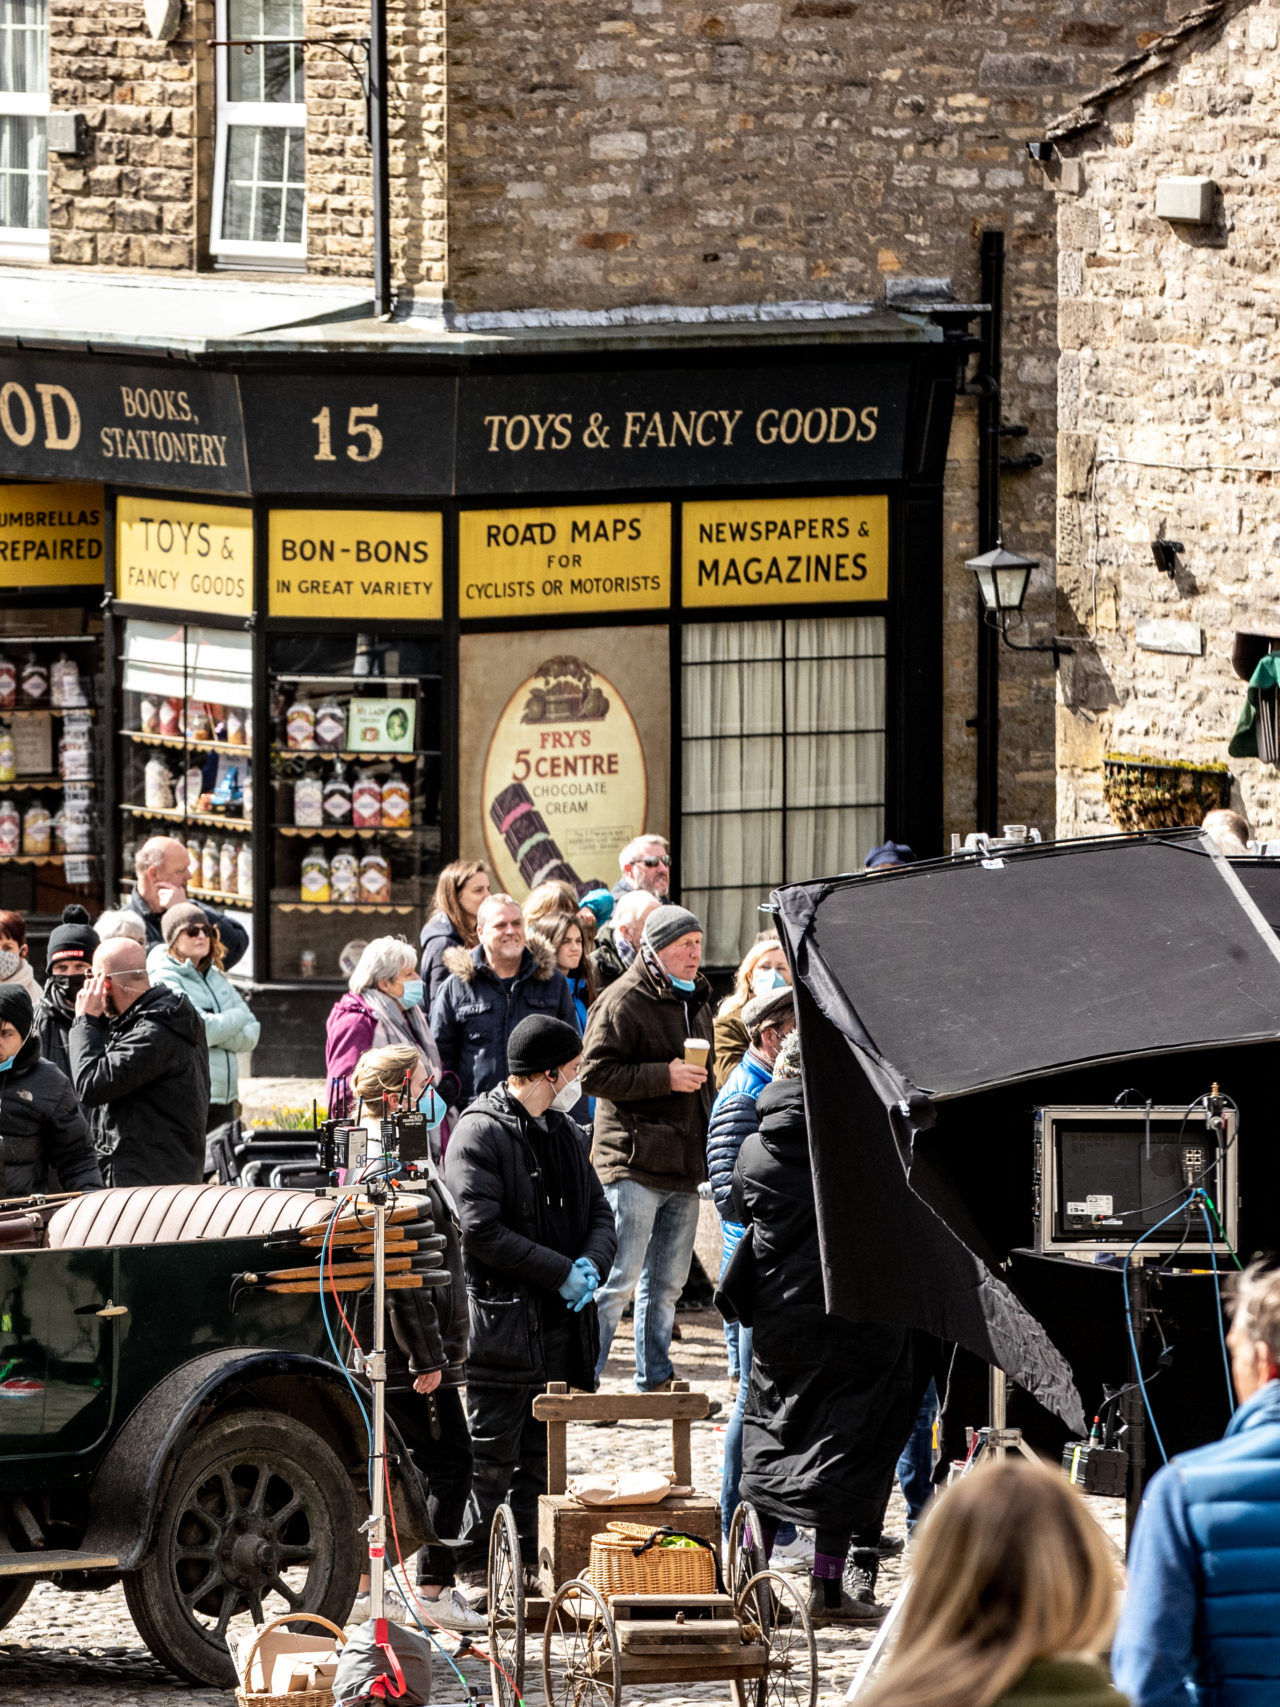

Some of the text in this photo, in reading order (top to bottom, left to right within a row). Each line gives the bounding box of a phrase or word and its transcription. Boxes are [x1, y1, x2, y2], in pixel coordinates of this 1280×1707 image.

[121, 386, 198, 424] BOOKS,
[312, 404, 383, 462] 15
[485, 407, 879, 452] TOYS & FANCY GOODS
[101, 427, 228, 467] STATIONERY
[140, 517, 234, 560] TOYS &
[487, 518, 642, 548] ROAD MAPS
[699, 517, 870, 544] NEWSPAPERS &
[281, 538, 429, 564] BON-BONS
[547, 554, 582, 569] FOR
[128, 567, 245, 598] FANCY GOODS
[698, 553, 868, 587] MAGAZINES
[276, 579, 433, 596] IN GREAT VARIETY
[465, 575, 661, 600] CYCLISTS OR MOTORISTS
[539, 729, 592, 750] FRY'S
[512, 749, 619, 782] 5 CENTRE
[533, 781, 608, 798] CHOCOLATE
[545, 801, 588, 816] CREAM
